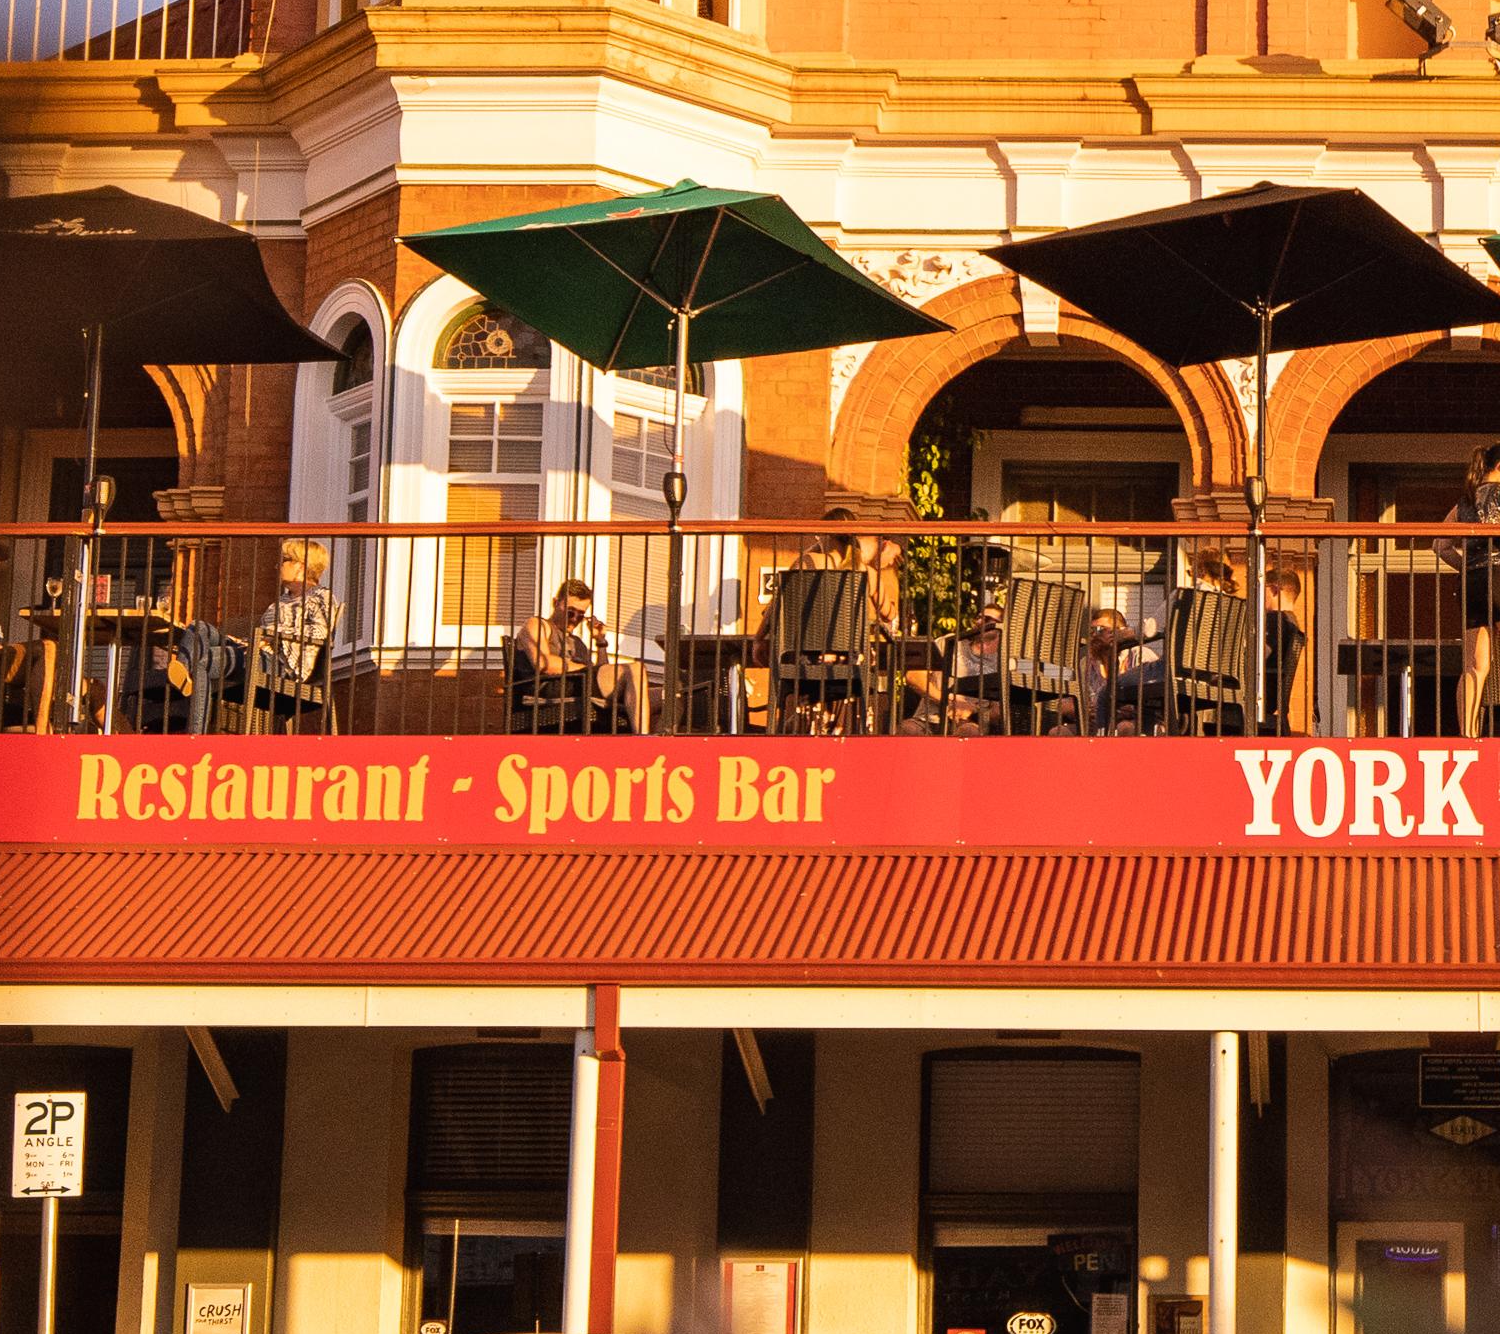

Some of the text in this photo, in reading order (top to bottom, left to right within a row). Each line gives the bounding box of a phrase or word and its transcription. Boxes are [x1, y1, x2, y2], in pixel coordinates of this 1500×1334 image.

[76, 753, 431, 822] Restaurant
[495, 753, 694, 834] Sports
[716, 755, 836, 823] Bar
[1234, 746, 1485, 838] YORK
[24, 1101, 75, 1135] 2P
[24, 1137, 74, 1147] ANGLE
[199, 1303, 242, 1318] CRUSH
[208, 1317, 233, 1326] THIRST
[1018, 1318, 1045, 1331] FOX
